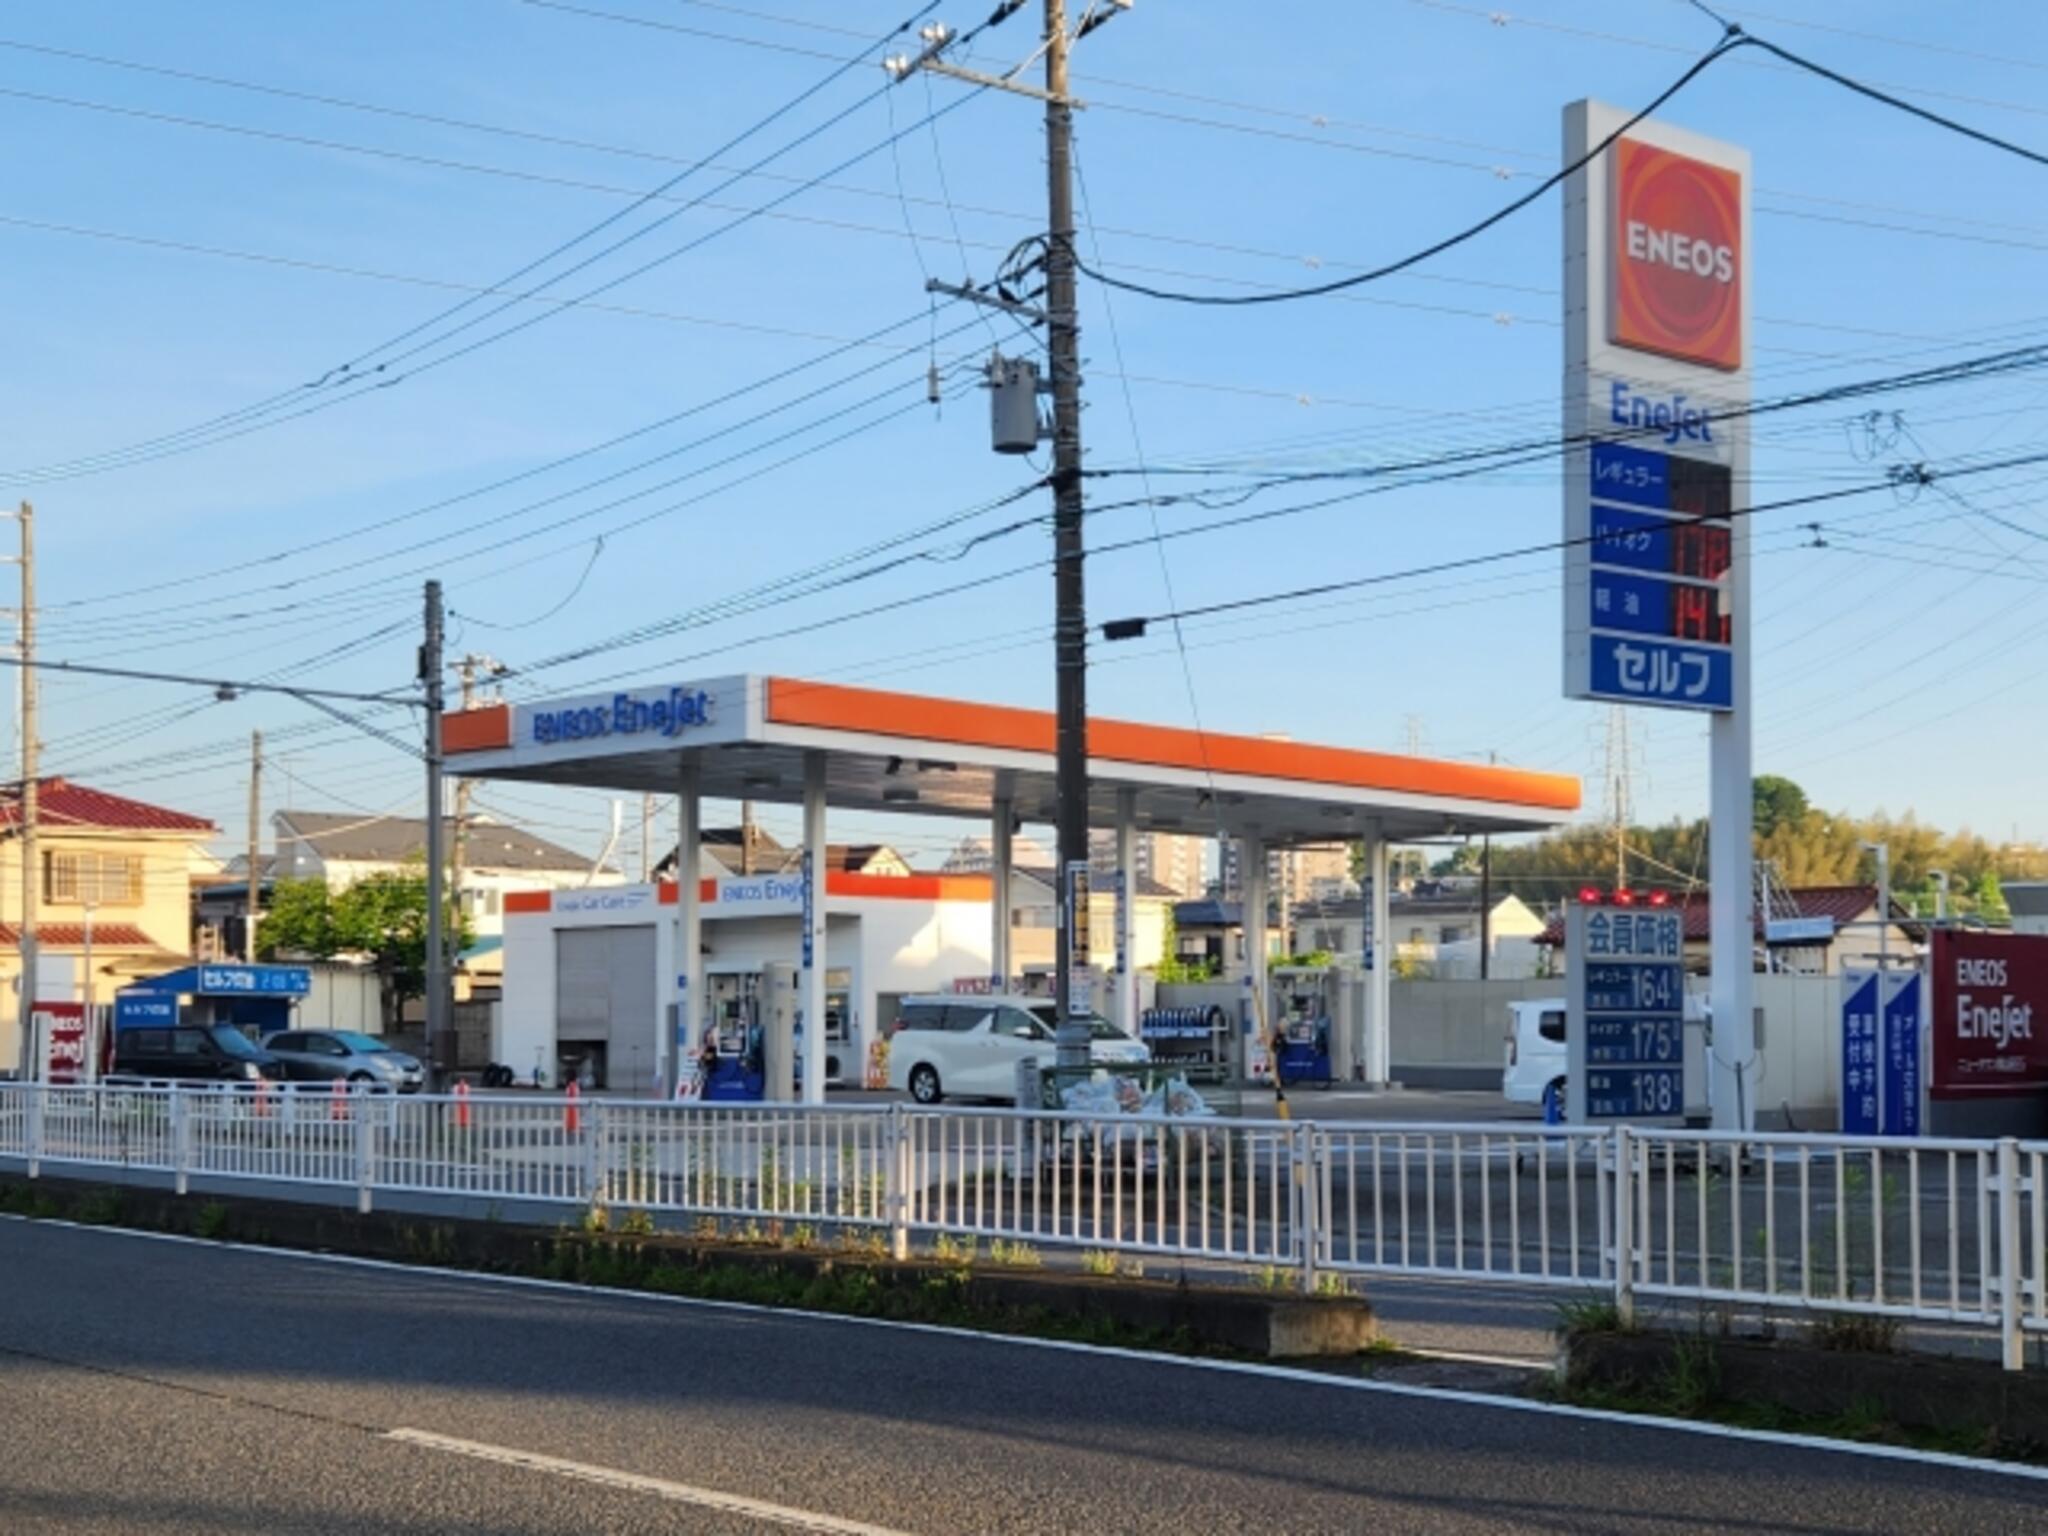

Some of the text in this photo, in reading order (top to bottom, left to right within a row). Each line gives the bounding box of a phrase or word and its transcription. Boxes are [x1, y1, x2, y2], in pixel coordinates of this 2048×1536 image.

[1626, 221, 1733, 282] ENEOS
[1611, 381, 1713, 444] Enejet
[1595, 457, 1663, 488] レギュラー
[1612, 642, 1710, 697] セルフ
[533, 686, 711, 744] ENEOS Enejet
[1588, 912, 1678, 956] 会員価格
[1632, 968, 1671, 1007] 164
[1957, 959, 2007, 986] ENEOS
[1631, 1021, 1672, 1059] 175
[1957, 995, 2033, 1049] Enejet
[1631, 1073, 1672, 1112] 138
